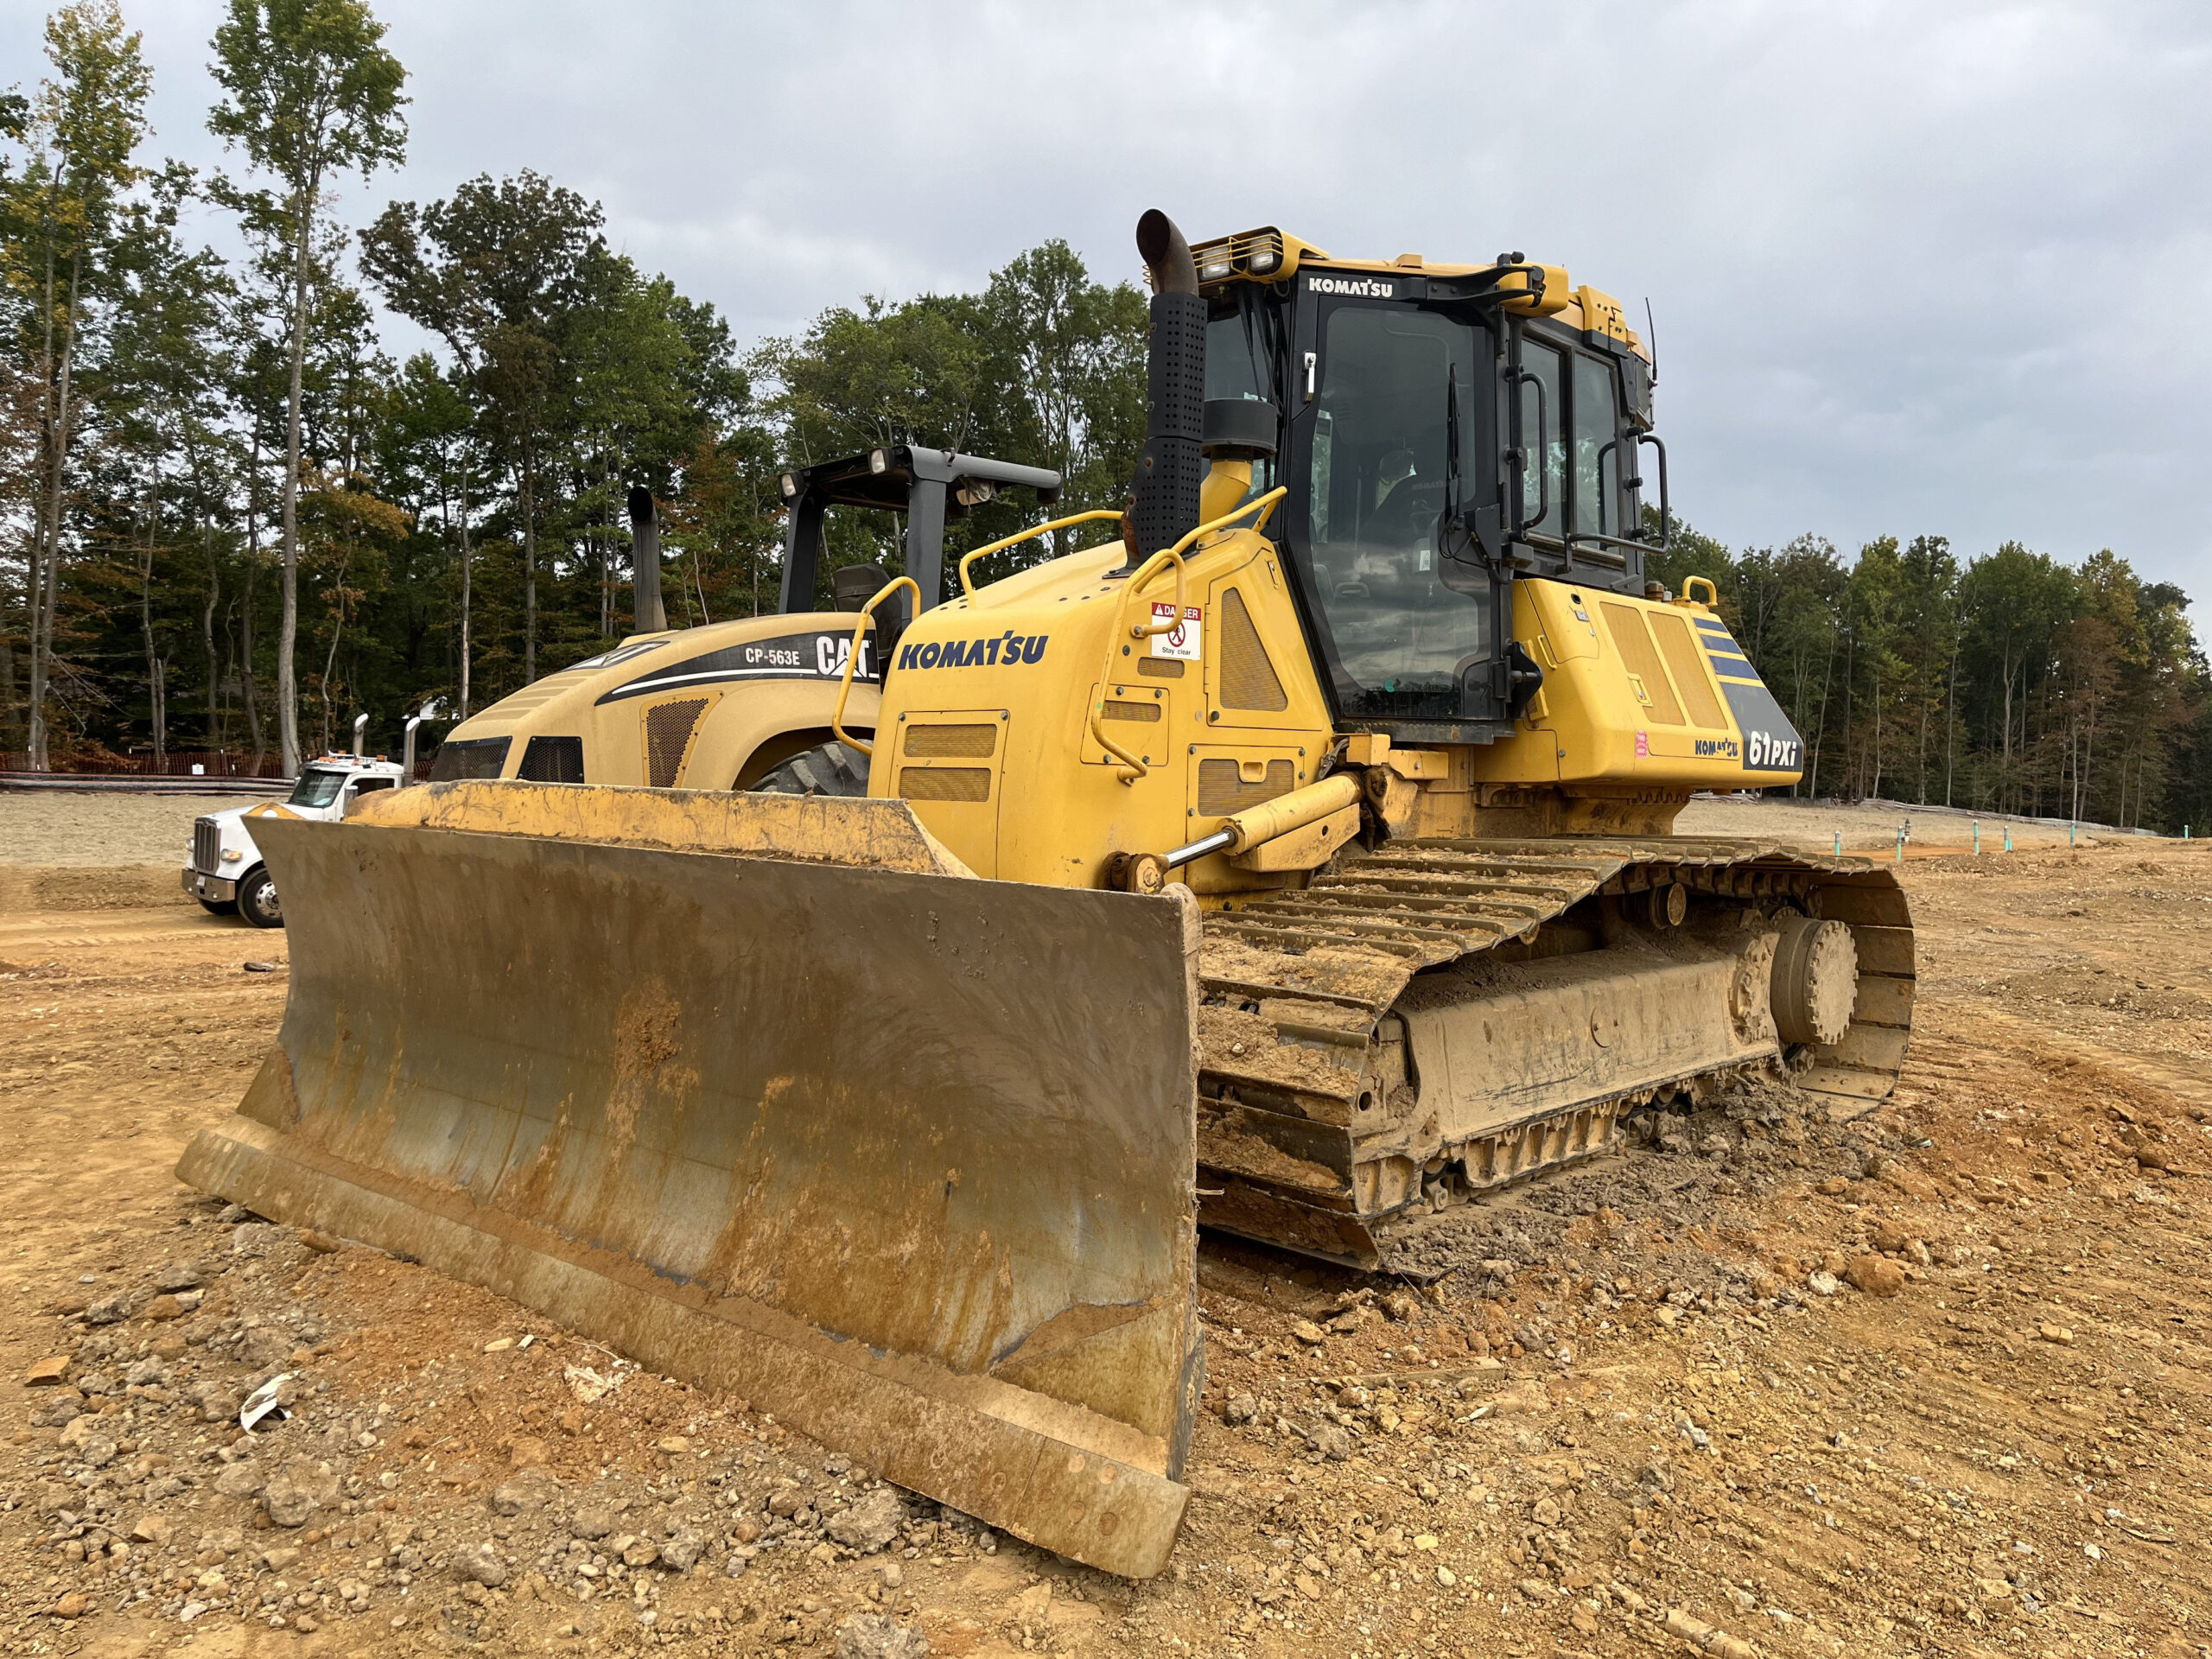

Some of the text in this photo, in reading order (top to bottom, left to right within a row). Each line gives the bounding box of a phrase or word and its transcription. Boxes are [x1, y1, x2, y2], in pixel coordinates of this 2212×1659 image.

[1309, 277, 1393, 297] KOMATSU
[1164, 605, 1198, 620] DAGER
[745, 647, 800, 665] CP-563E
[816, 636, 869, 677] CAT
[898, 630, 1049, 670] KOMATSU
[1161, 646, 1174, 655] Stay
